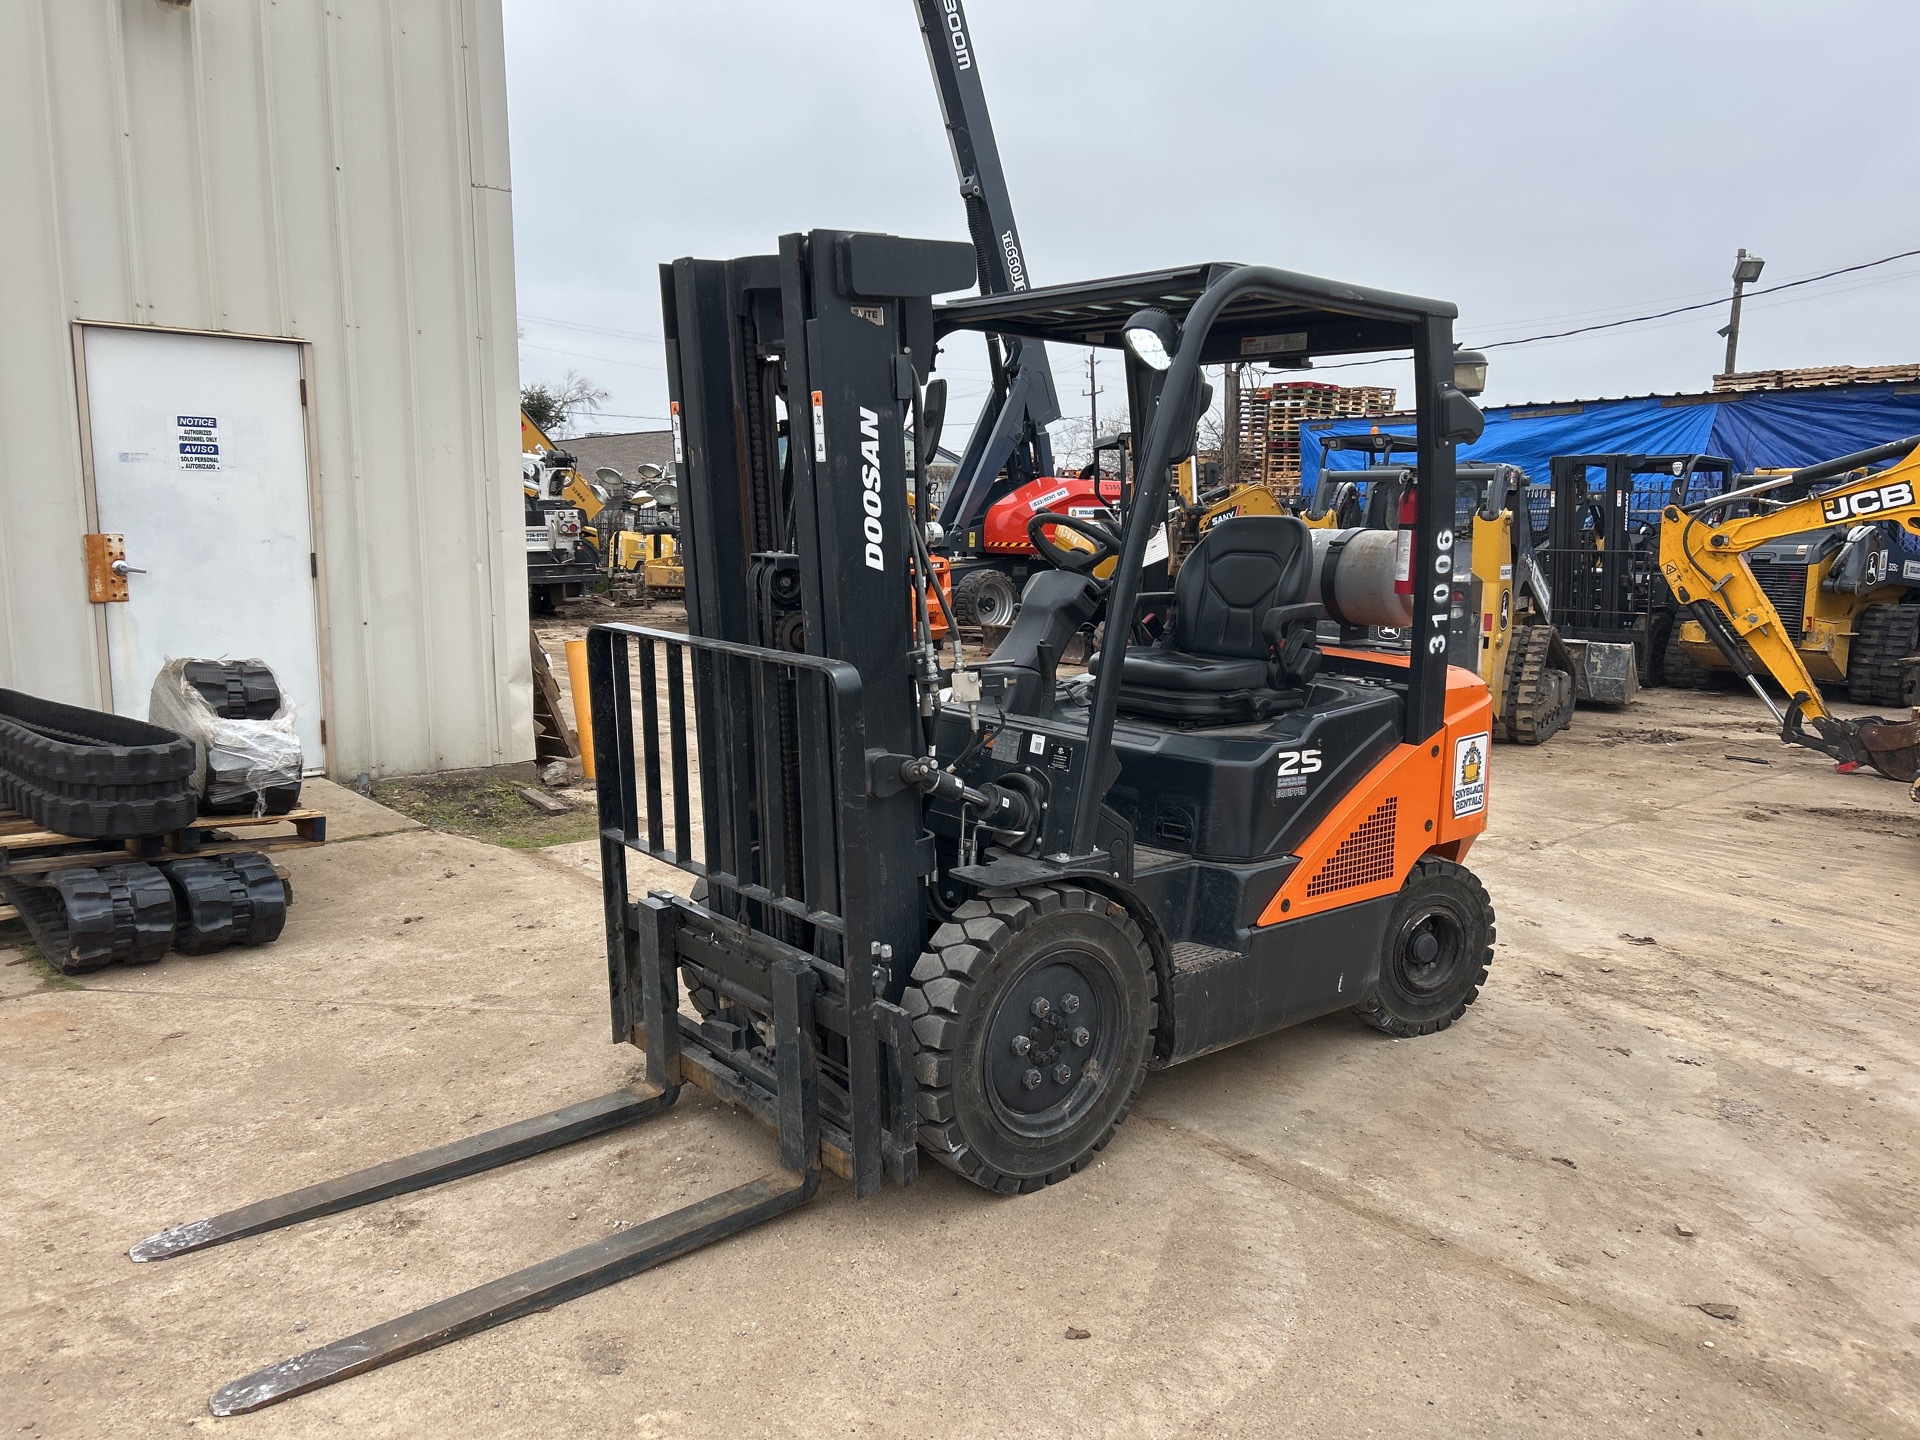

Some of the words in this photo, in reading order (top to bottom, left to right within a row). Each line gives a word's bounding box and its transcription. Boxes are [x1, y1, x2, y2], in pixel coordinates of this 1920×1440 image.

[180, 418, 214, 426] NOTICE
[184, 445, 215, 453] AVISO
[860, 406, 884, 572] DOOSAN
[1825, 483, 1913, 520] JCB
[1211, 510, 1235, 526] SANY
[1429, 529, 1453, 654] 31006
[1277, 750, 1322, 776] 25
[1276, 786, 1307, 798] EQUIPPED
[1455, 784, 1484, 800] SKYBLACK
[1456, 795, 1482, 811] RENTALS
